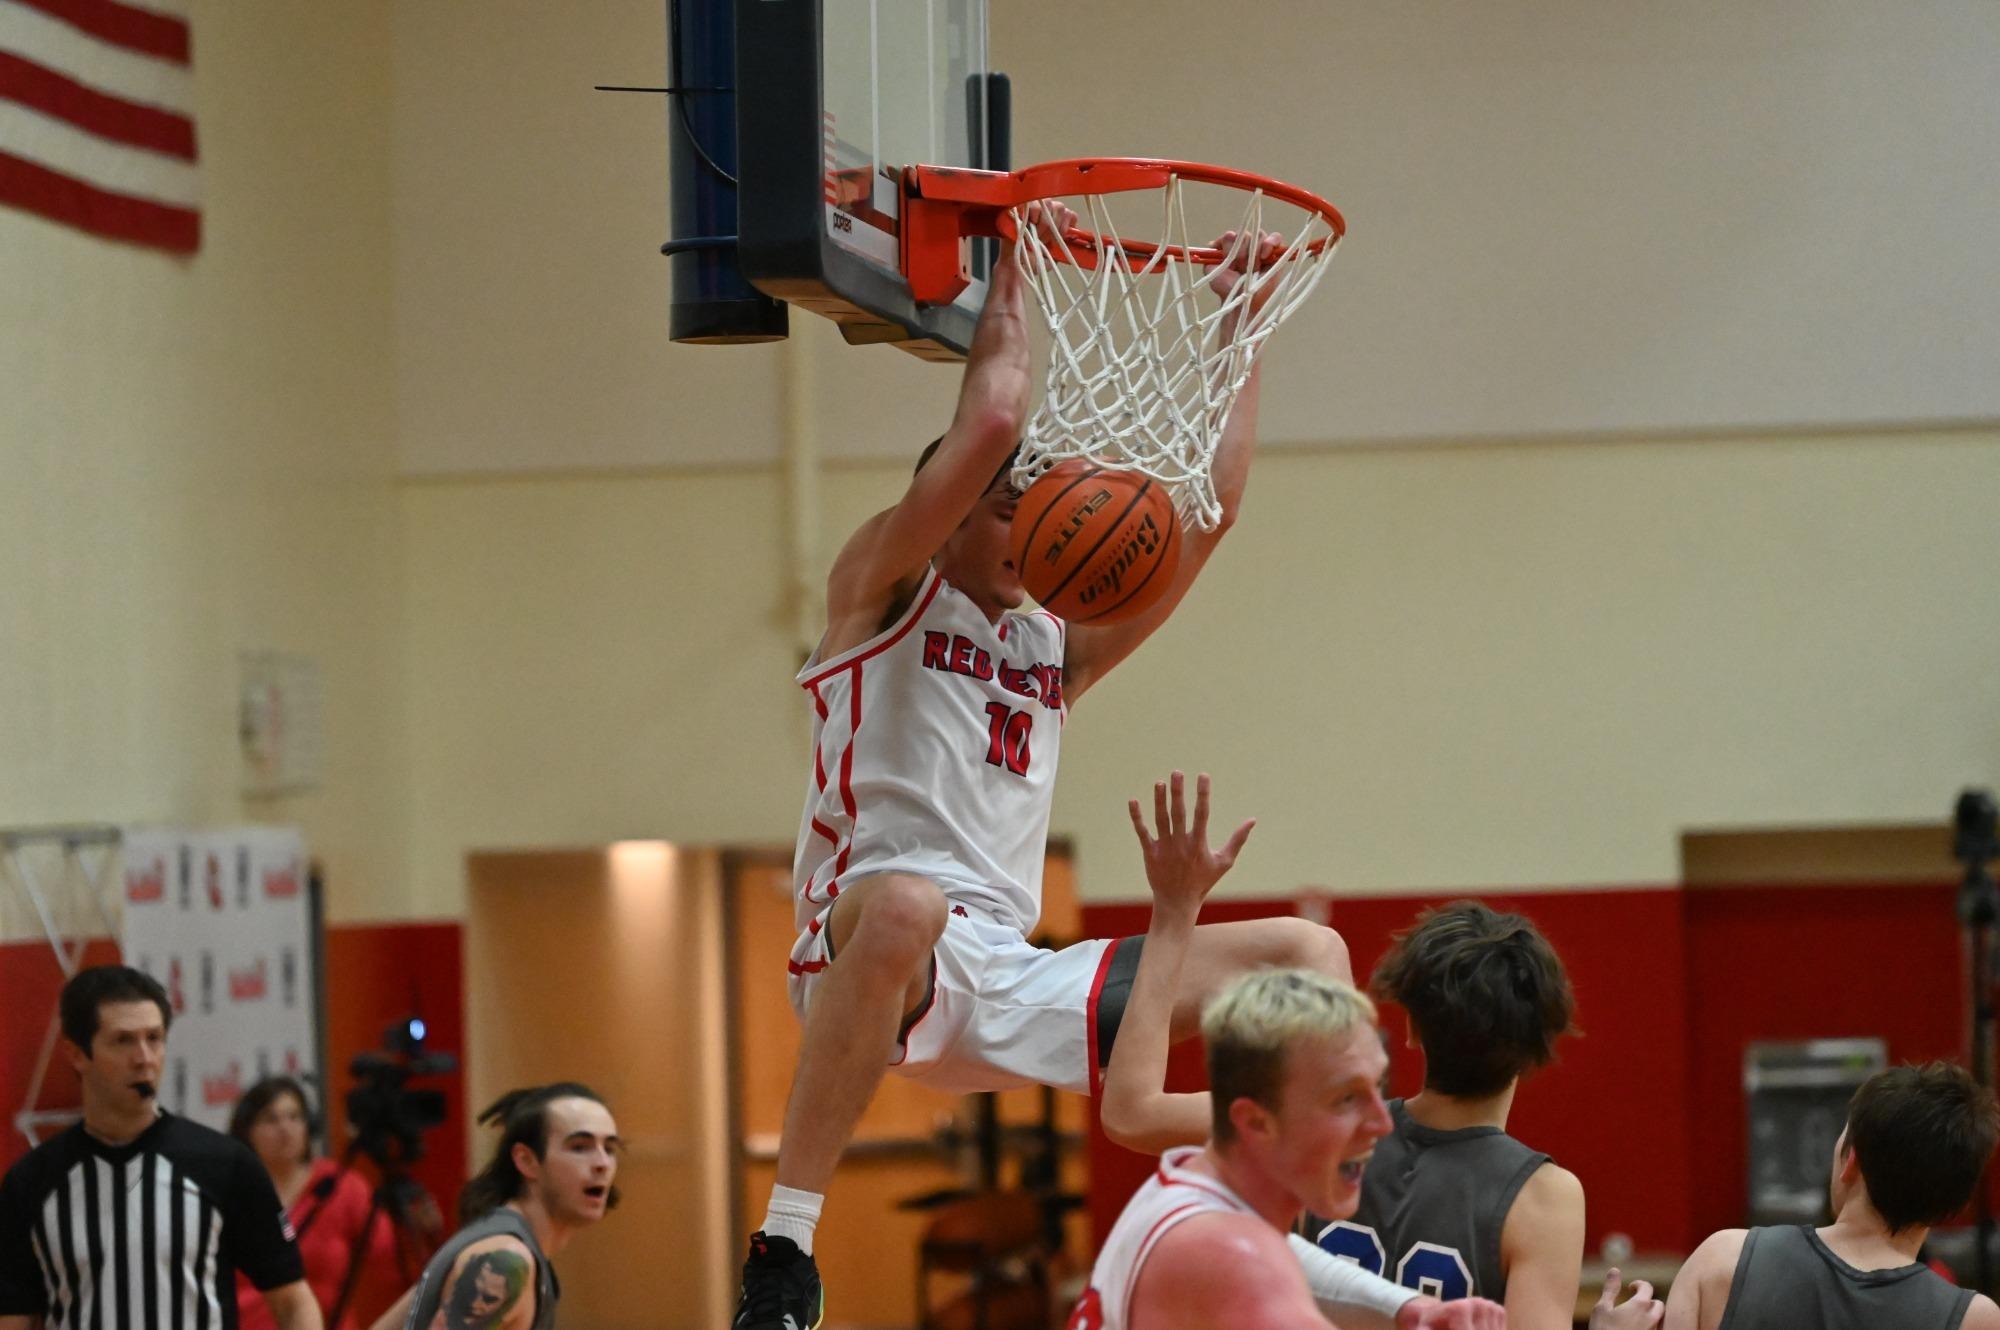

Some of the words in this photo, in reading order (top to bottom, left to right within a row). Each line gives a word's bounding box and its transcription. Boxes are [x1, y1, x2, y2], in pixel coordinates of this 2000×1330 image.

[1044, 488, 1113, 567] ELITE
[1078, 512, 1161, 604] Baden
[922, 630, 994, 682] RED
[985, 701, 1033, 778] 10
